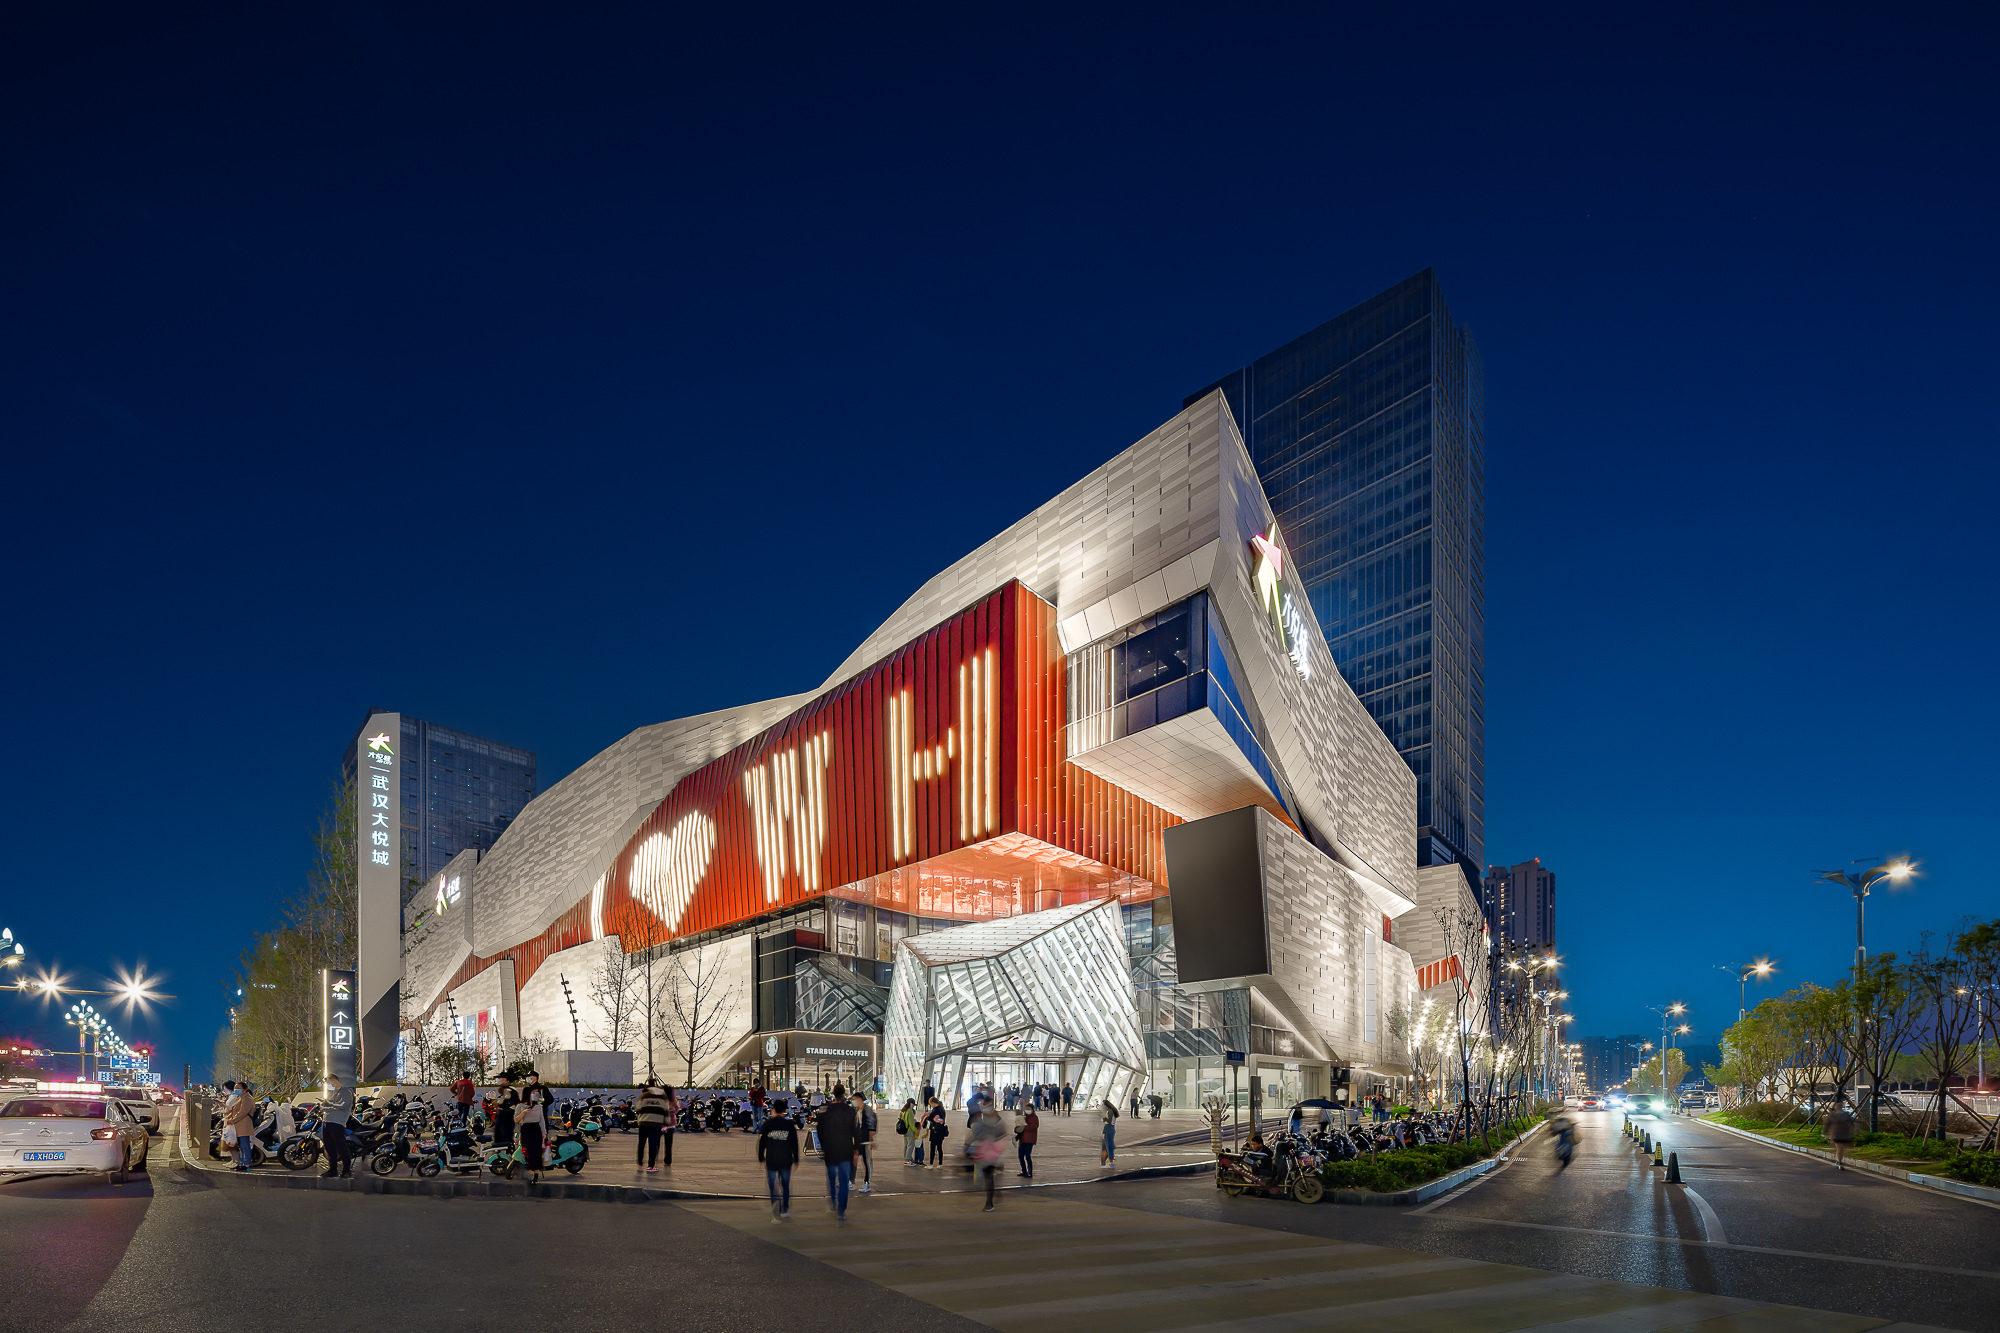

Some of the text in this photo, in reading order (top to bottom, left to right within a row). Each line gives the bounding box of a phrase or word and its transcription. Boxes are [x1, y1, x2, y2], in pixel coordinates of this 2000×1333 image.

[372, 775, 389, 866] 武汉大悦城
[806, 1047, 869, 1057] STARBUCKS COFFEE
